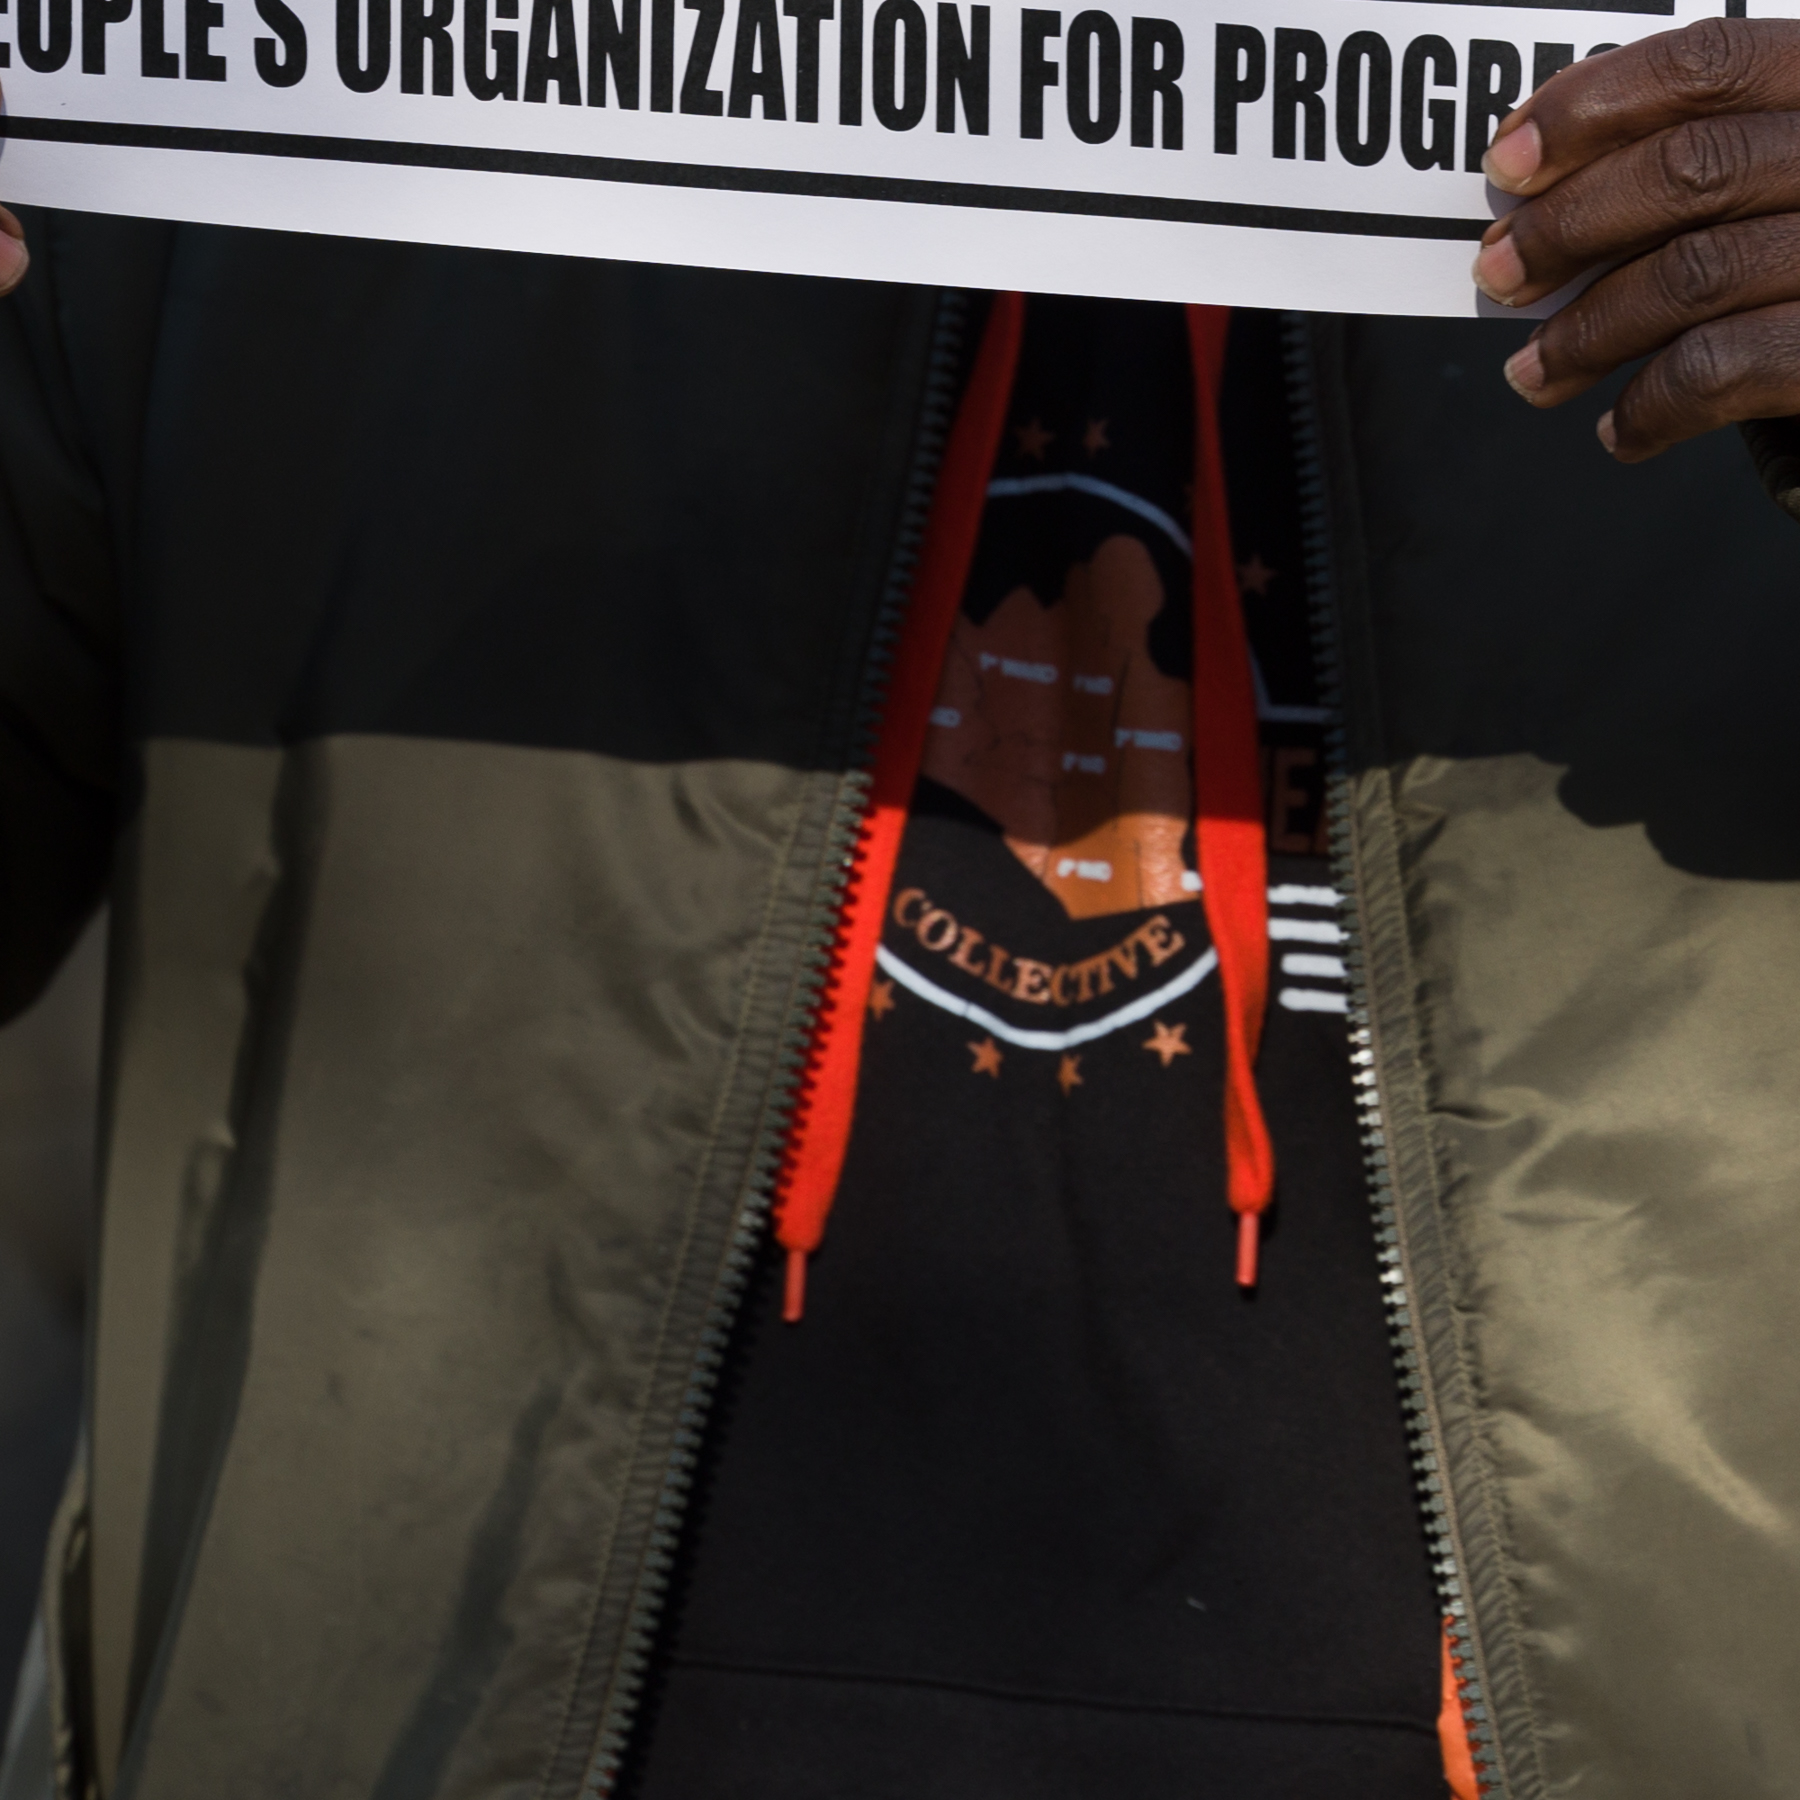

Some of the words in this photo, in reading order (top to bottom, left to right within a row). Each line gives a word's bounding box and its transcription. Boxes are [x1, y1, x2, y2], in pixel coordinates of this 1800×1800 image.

[1020, 7, 1185, 151] FOR
[1214, 22, 1626, 174] PROGR
[893, 886, 1186, 1007] COLLECTIVE
